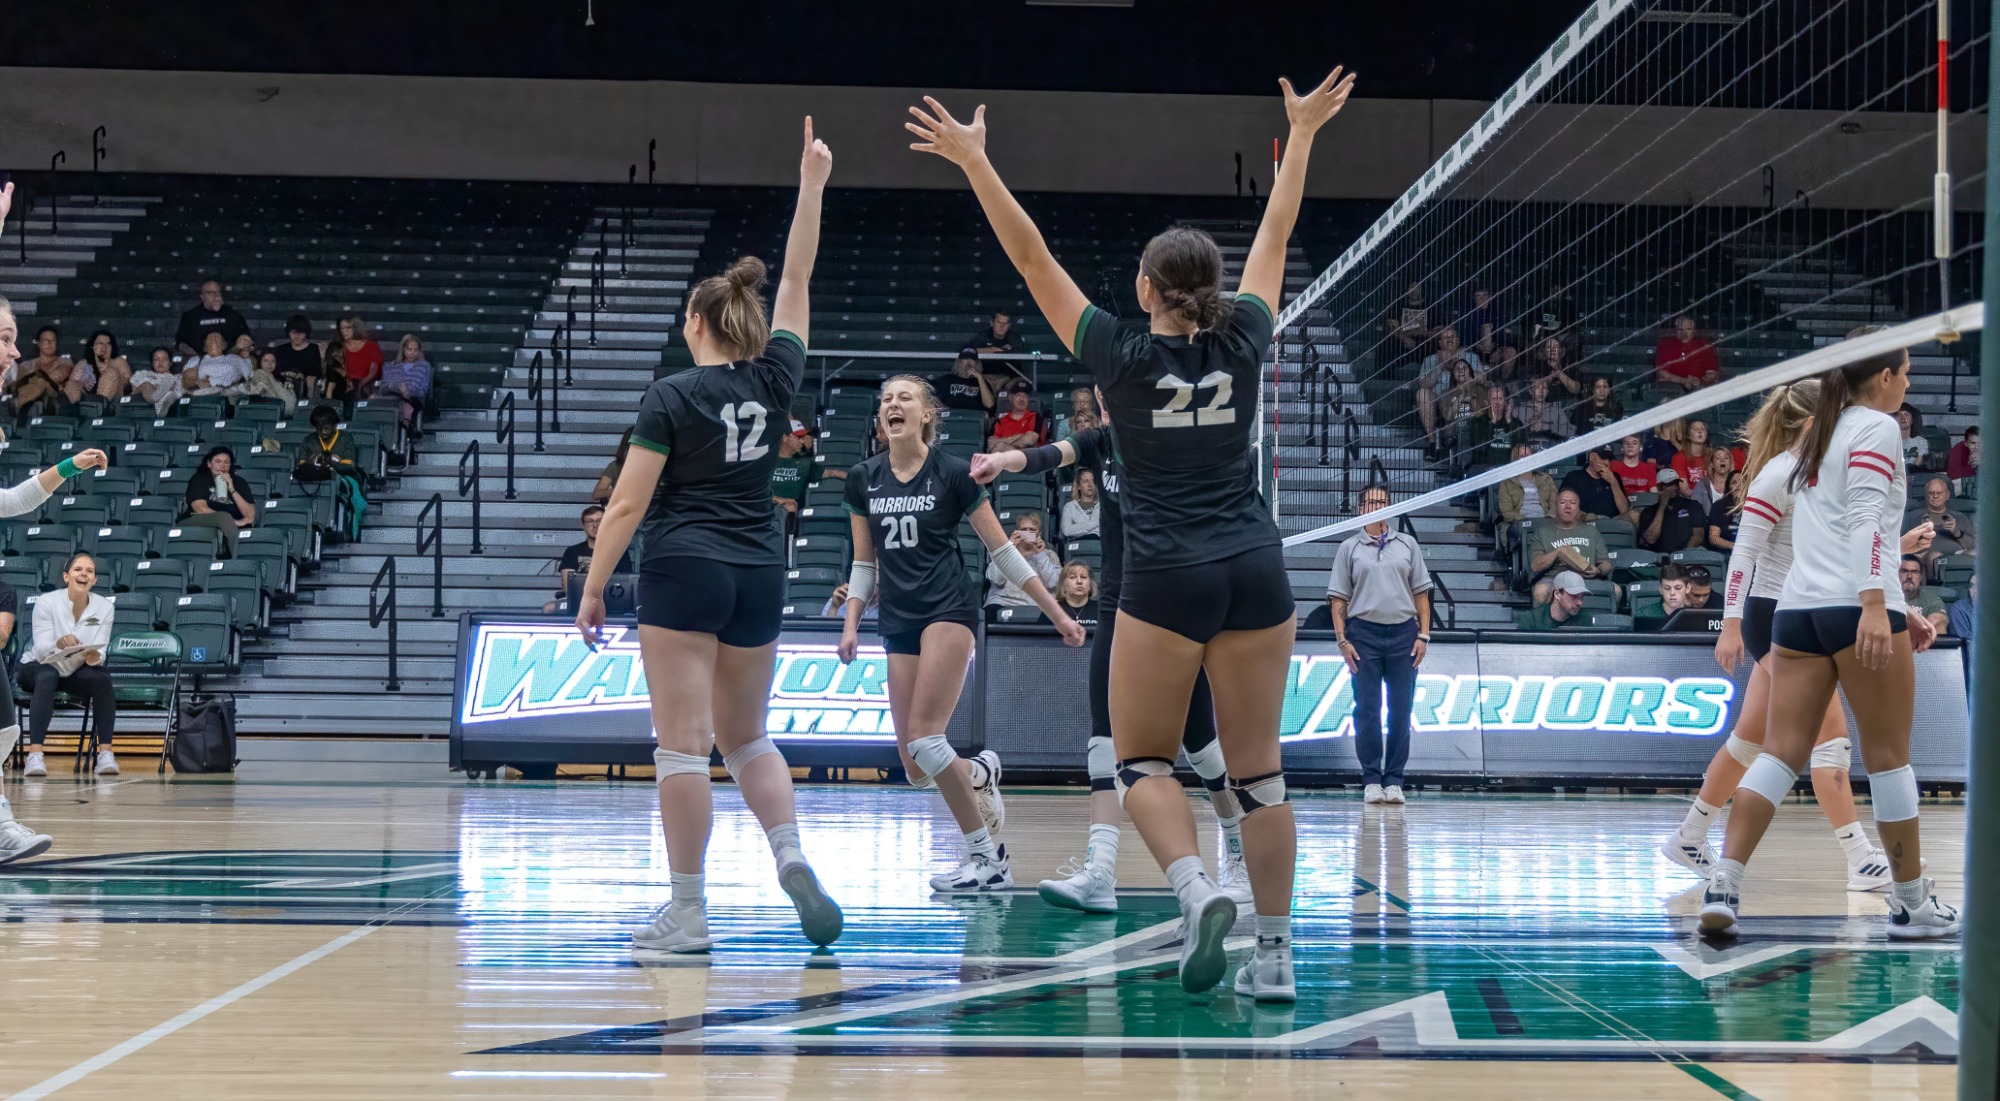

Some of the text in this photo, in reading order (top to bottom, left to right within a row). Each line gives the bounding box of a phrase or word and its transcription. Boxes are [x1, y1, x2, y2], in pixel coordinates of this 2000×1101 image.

[1152, 370, 1236, 428] 22
[720, 401, 769, 462] 12
[869, 494, 936, 515] WARRIORS
[880, 515, 919, 550] 20
[1551, 537, 1590, 549] WARRIORS
[1870, 531, 1882, 577] FIGHTING
[1726, 570, 1744, 606] FIGHTING
[120, 639, 167, 648] WARRIOR
